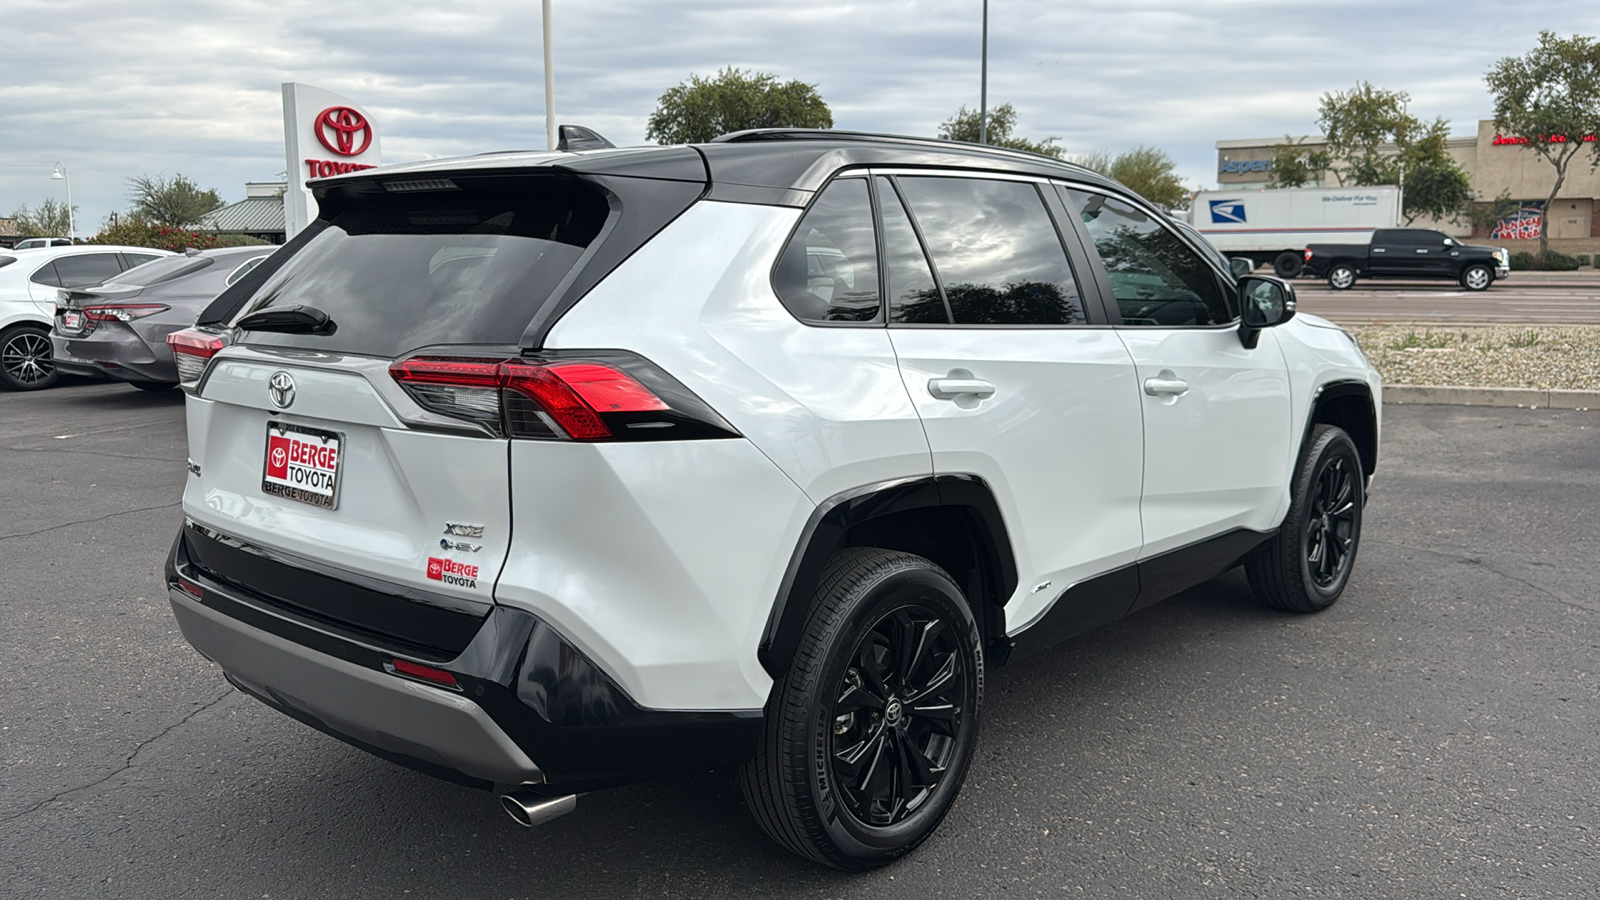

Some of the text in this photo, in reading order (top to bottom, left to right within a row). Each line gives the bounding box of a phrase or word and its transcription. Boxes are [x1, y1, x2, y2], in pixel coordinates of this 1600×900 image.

[1219, 159, 1272, 175] Aspen
[1494, 217, 1541, 232] Jersey
[290, 439, 336, 470] BERGE
[289, 466, 334, 491] TOYOTA
[265, 482, 333, 507] BERGE TOYOTA
[443, 522, 484, 538] XSE
[443, 558, 479, 578] BERGE
[443, 574, 477, 589] TOYOTA
[816, 709, 827, 791] MICHELIN
